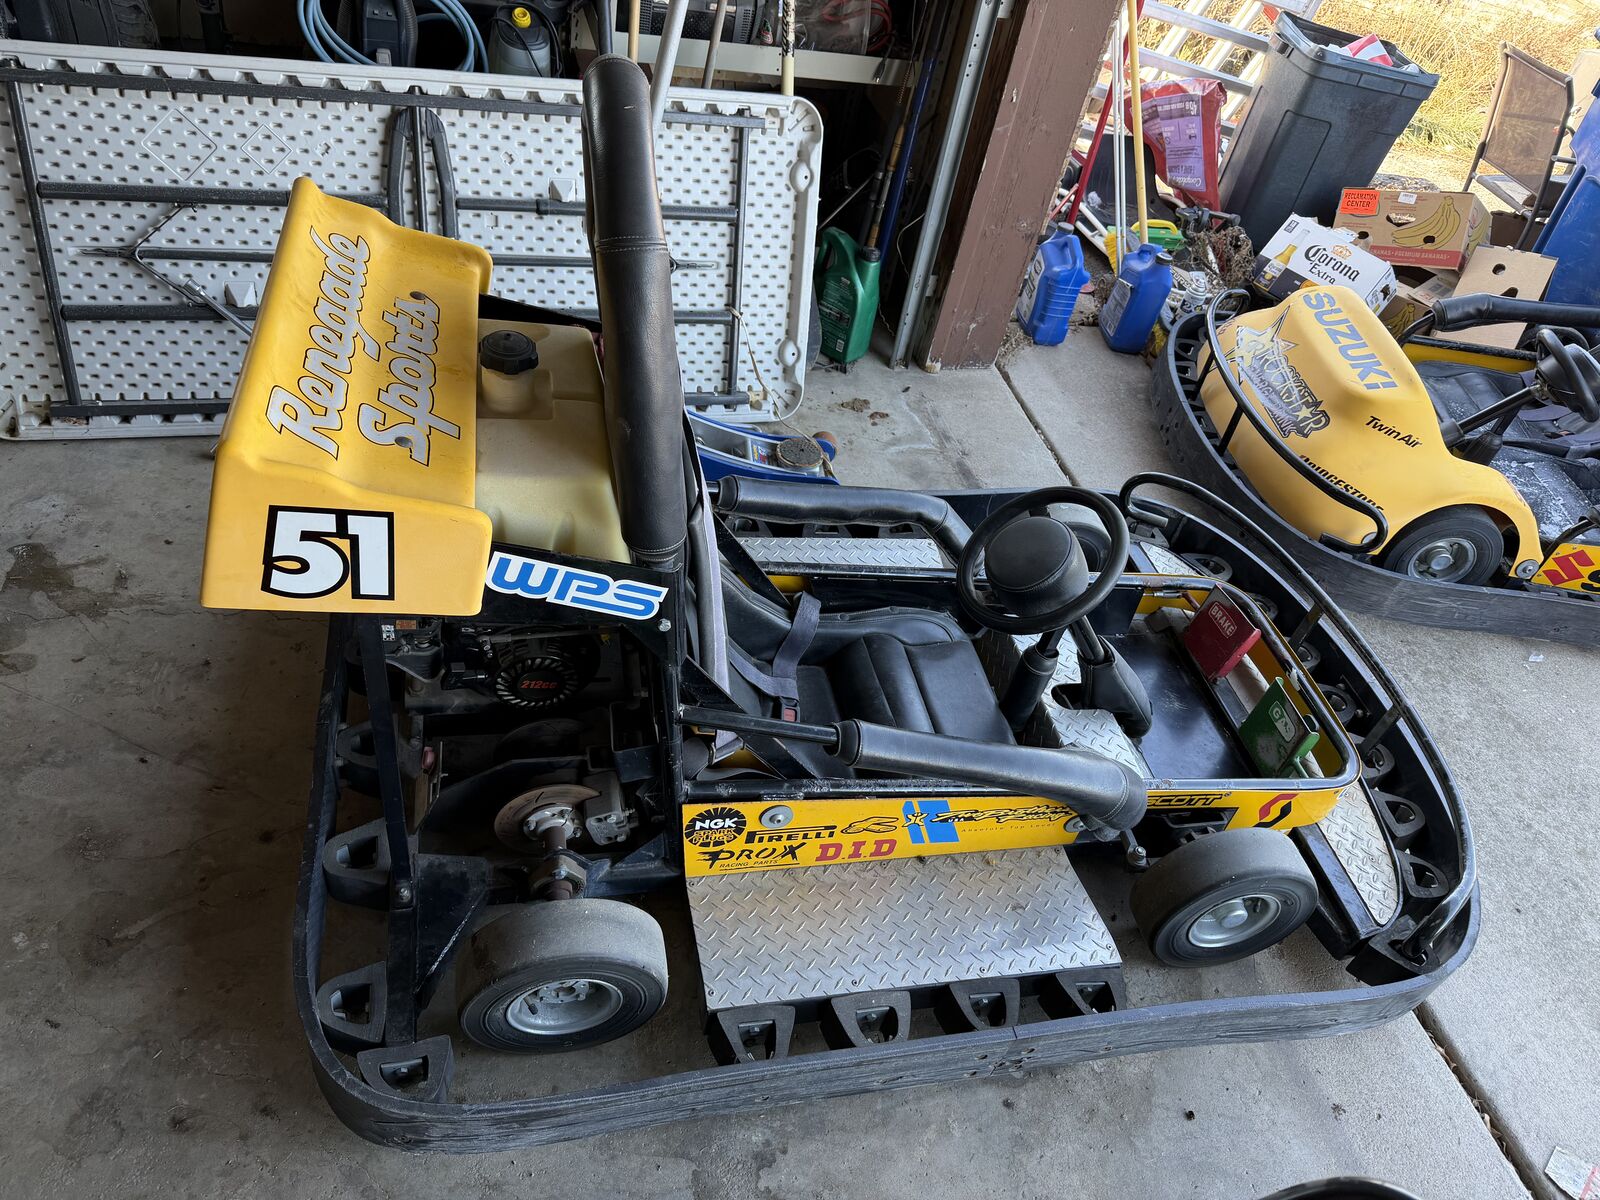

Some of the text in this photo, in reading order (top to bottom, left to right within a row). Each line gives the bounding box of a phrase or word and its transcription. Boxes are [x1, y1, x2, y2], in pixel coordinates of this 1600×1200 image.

[1344, 192, 1377, 201] RECLAMATION
[1346, 200, 1371, 208] CENTER
[1304, 244, 1360, 282] Corona
[1308, 263, 1336, 285] Extra
[265, 225, 381, 460] Renegade
[1302, 293, 1398, 390] SUZUKI
[357, 292, 461, 467] Sports
[262, 505, 394, 600] 51
[491, 555, 664, 617] WPS
[1210, 605, 1236, 637] BRAKE
[521, 679, 557, 690] 212cc
[1147, 793, 1224, 808] SCOTT
[694, 817, 738, 830] NGK
[694, 828, 733, 836] SPARK
[744, 825, 837, 844] PIRELLI
[691, 833, 735, 846] PLUGS
[815, 839, 898, 862] D.I.D
